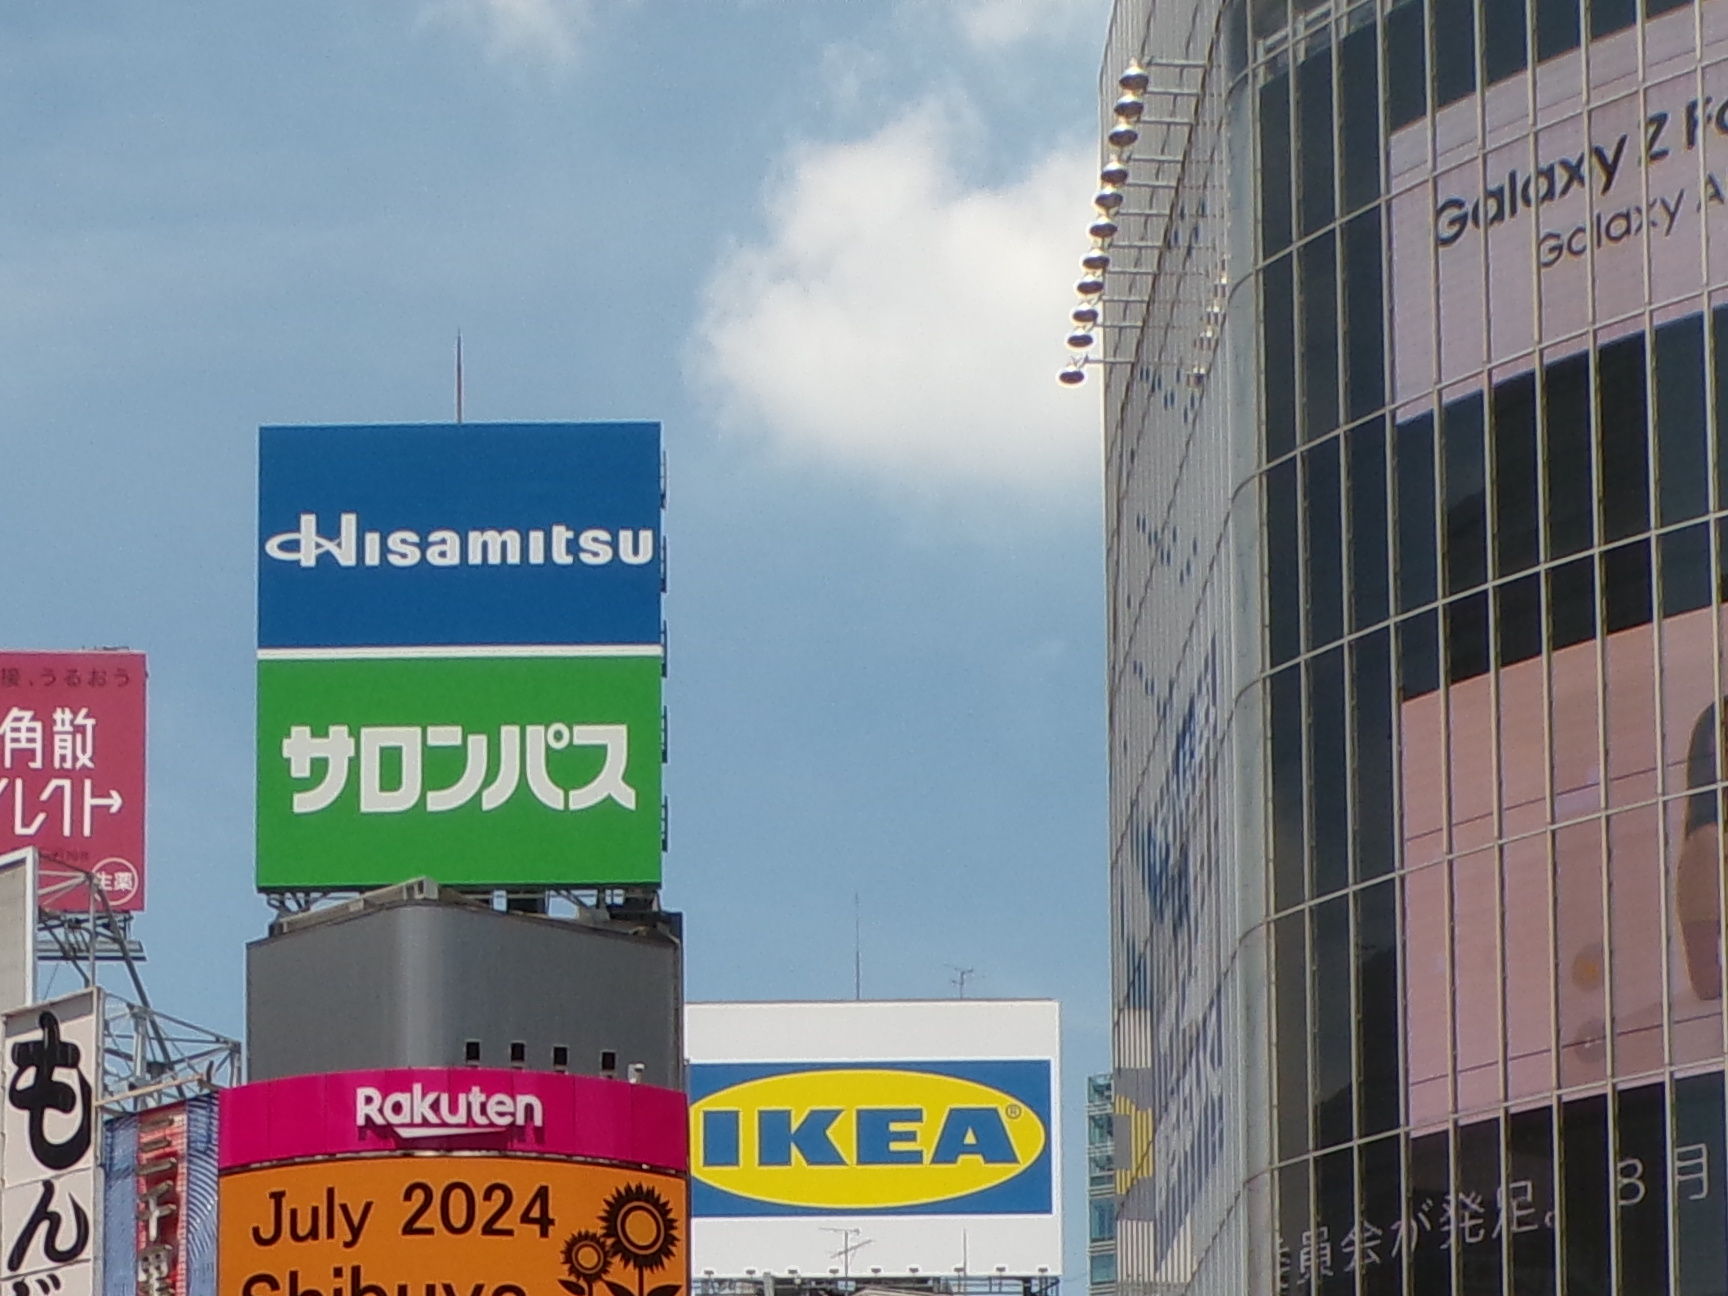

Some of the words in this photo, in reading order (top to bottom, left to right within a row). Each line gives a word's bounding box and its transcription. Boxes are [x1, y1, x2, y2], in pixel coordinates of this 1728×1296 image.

[1434, 132, 1629, 247] Galaxy
[1638, 110, 1670, 168] Z
[1535, 187, 1686, 268] Galaxy
[265, 511, 655, 568] Hisamitsu
[282, 721, 636, 814] サロンパス
[355, 1082, 543, 1132] Rakuten
[701, 1106, 1020, 1167] IKEA
[250, 1186, 374, 1250] July
[400, 1181, 556, 1239] 2024
